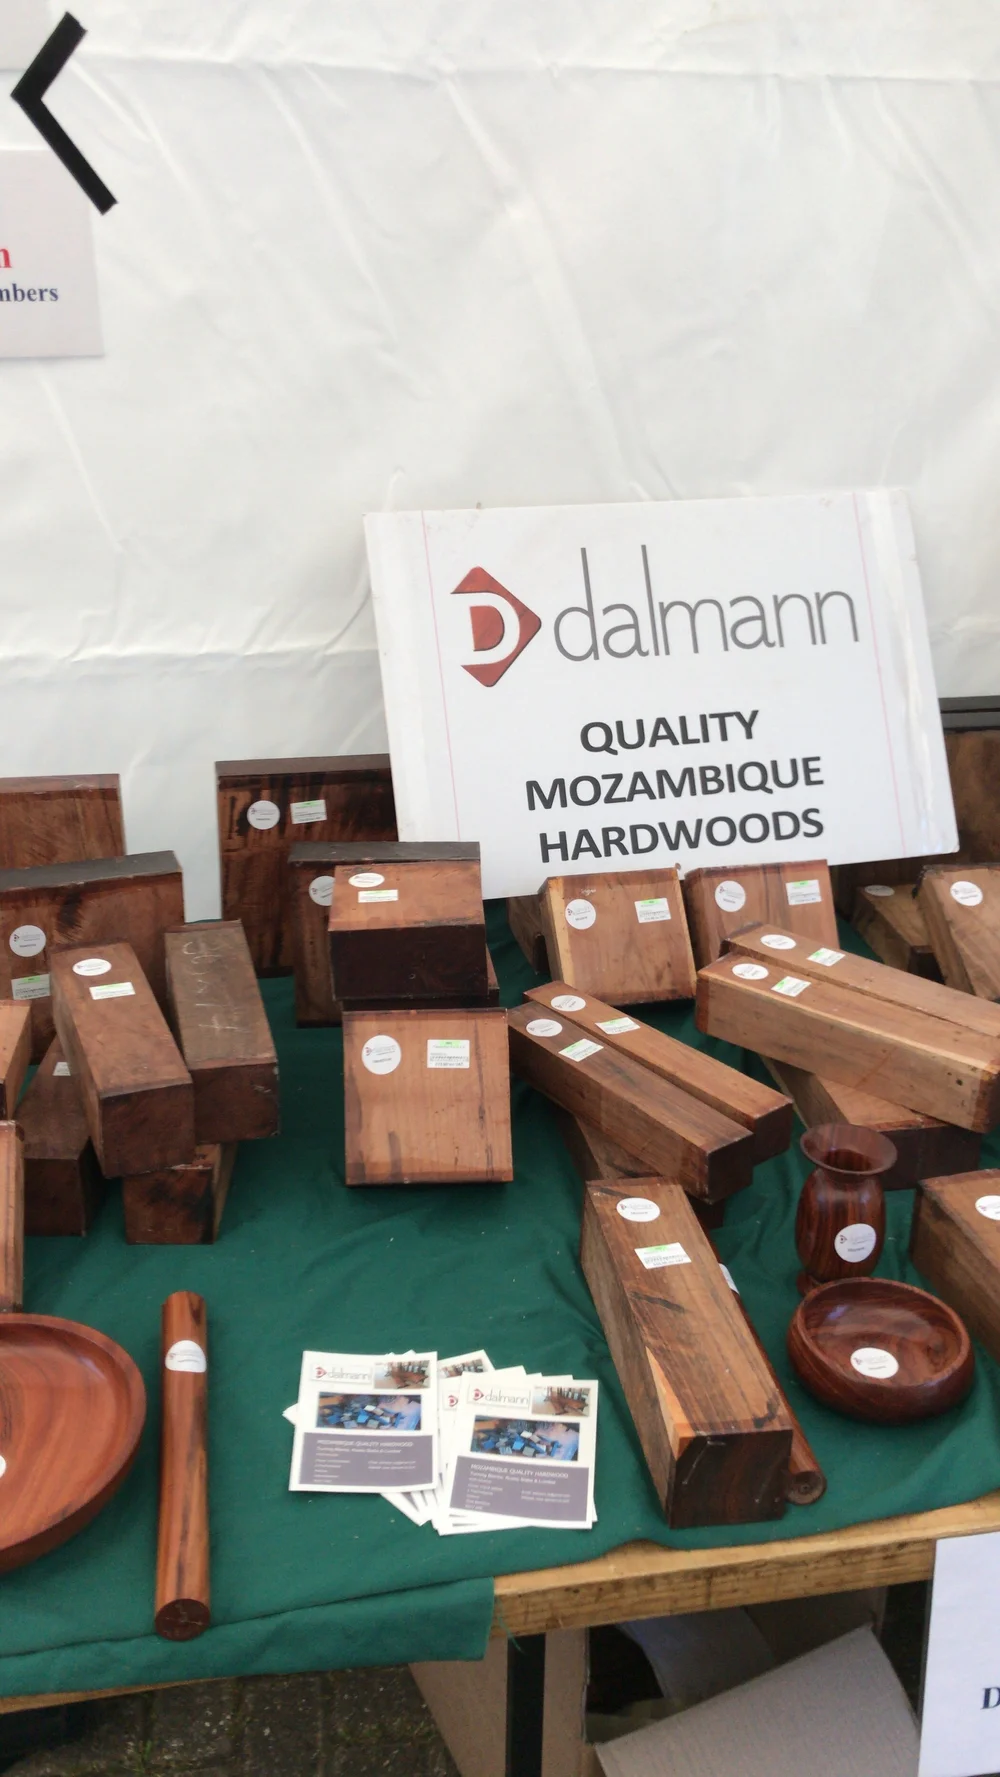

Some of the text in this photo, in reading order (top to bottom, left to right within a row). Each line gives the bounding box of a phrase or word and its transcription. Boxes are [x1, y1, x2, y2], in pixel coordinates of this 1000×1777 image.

[553, 544, 860, 662] dalmann
[580, 710, 759, 755] QUALITY
[525, 756, 824, 811] MOZAMBIQUE
[539, 808, 824, 863] HARDWOODS
